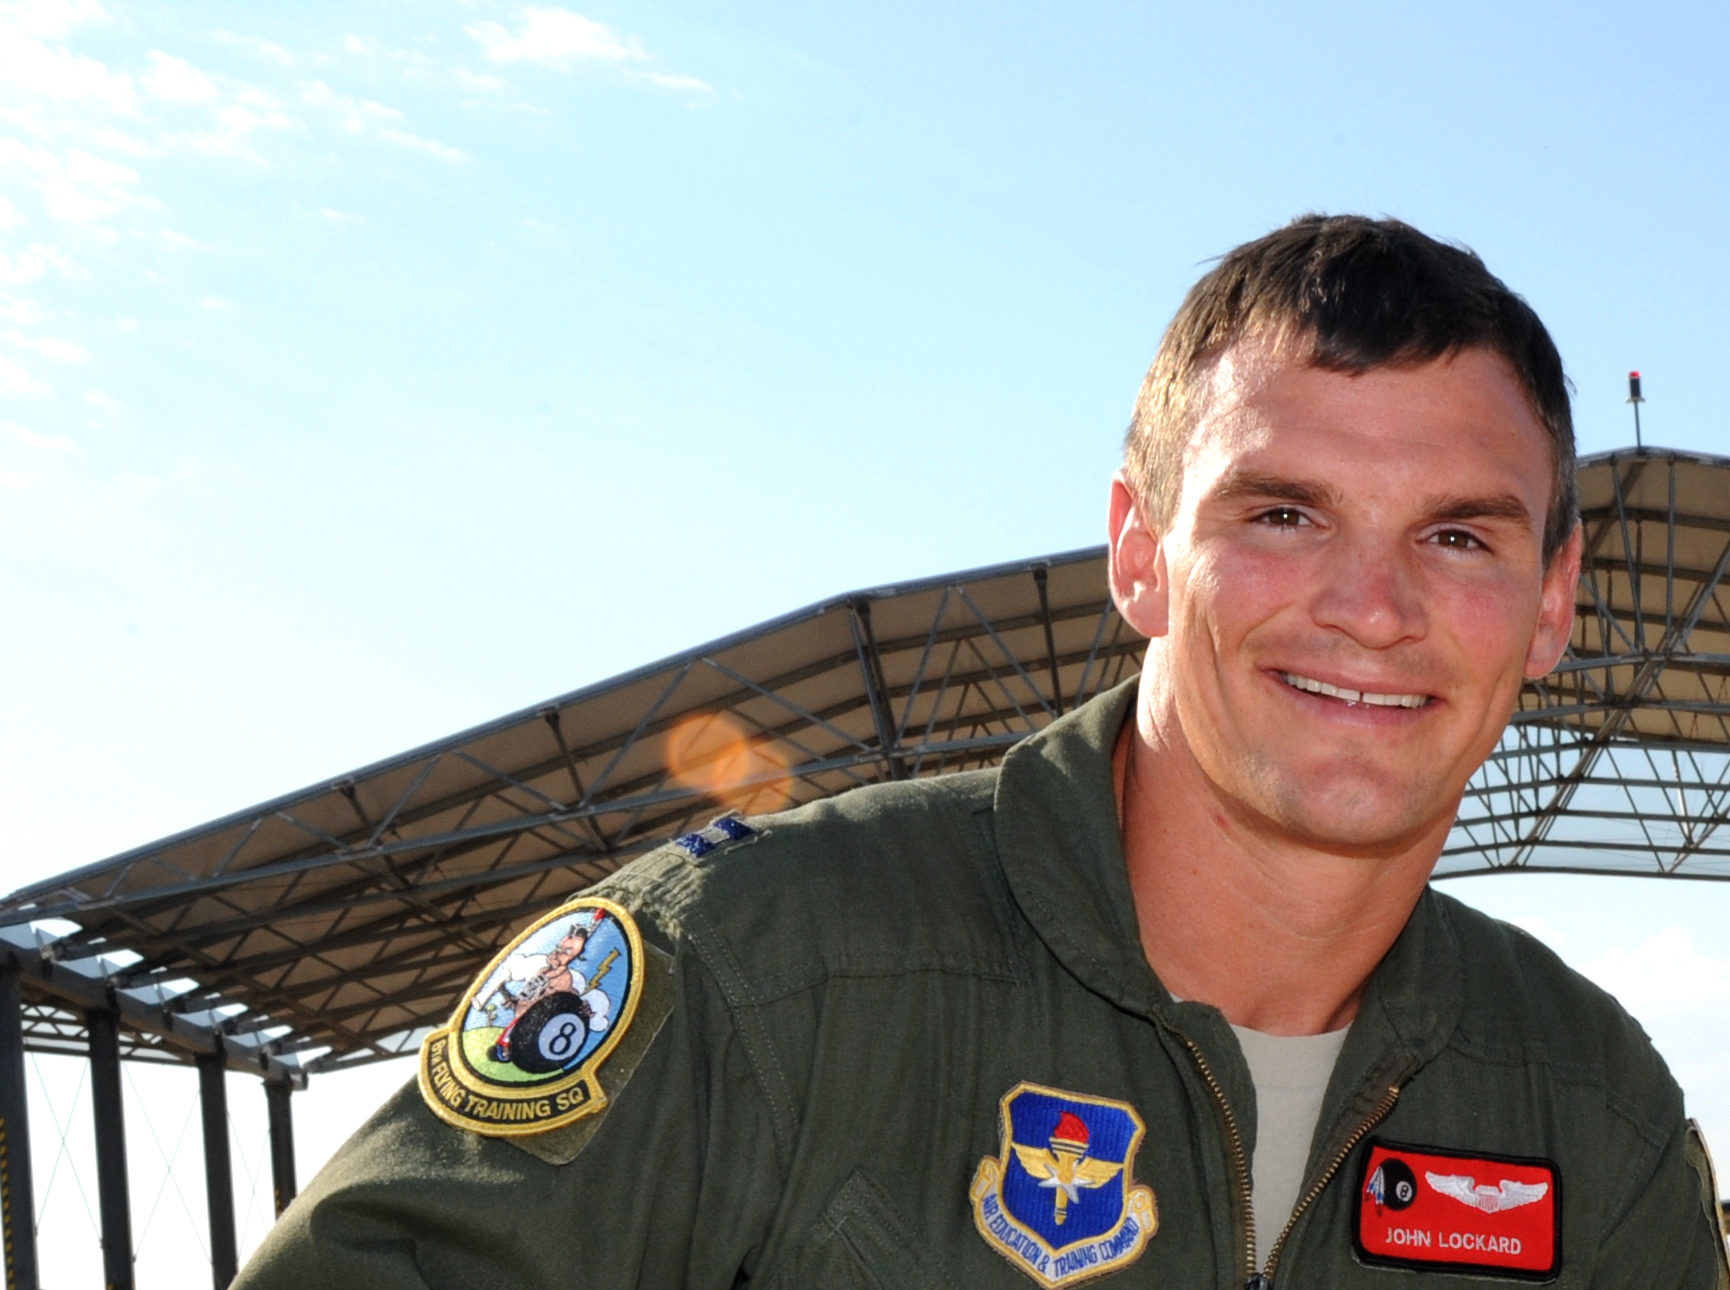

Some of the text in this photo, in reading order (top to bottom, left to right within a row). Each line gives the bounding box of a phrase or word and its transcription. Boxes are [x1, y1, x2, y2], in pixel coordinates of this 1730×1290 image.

[549, 1022, 576, 1055] 8
[431, 1061, 467, 1108] FLYING
[463, 1095, 551, 1121] TRAINING
[556, 1087, 584, 1111] SQ
[1399, 1184, 1408, 1199] 8
[982, 1193, 1140, 1278] AIR EDUCATION & TRAINING COMMAND
[1385, 1226, 1521, 1254] JOHN LOCKARD
